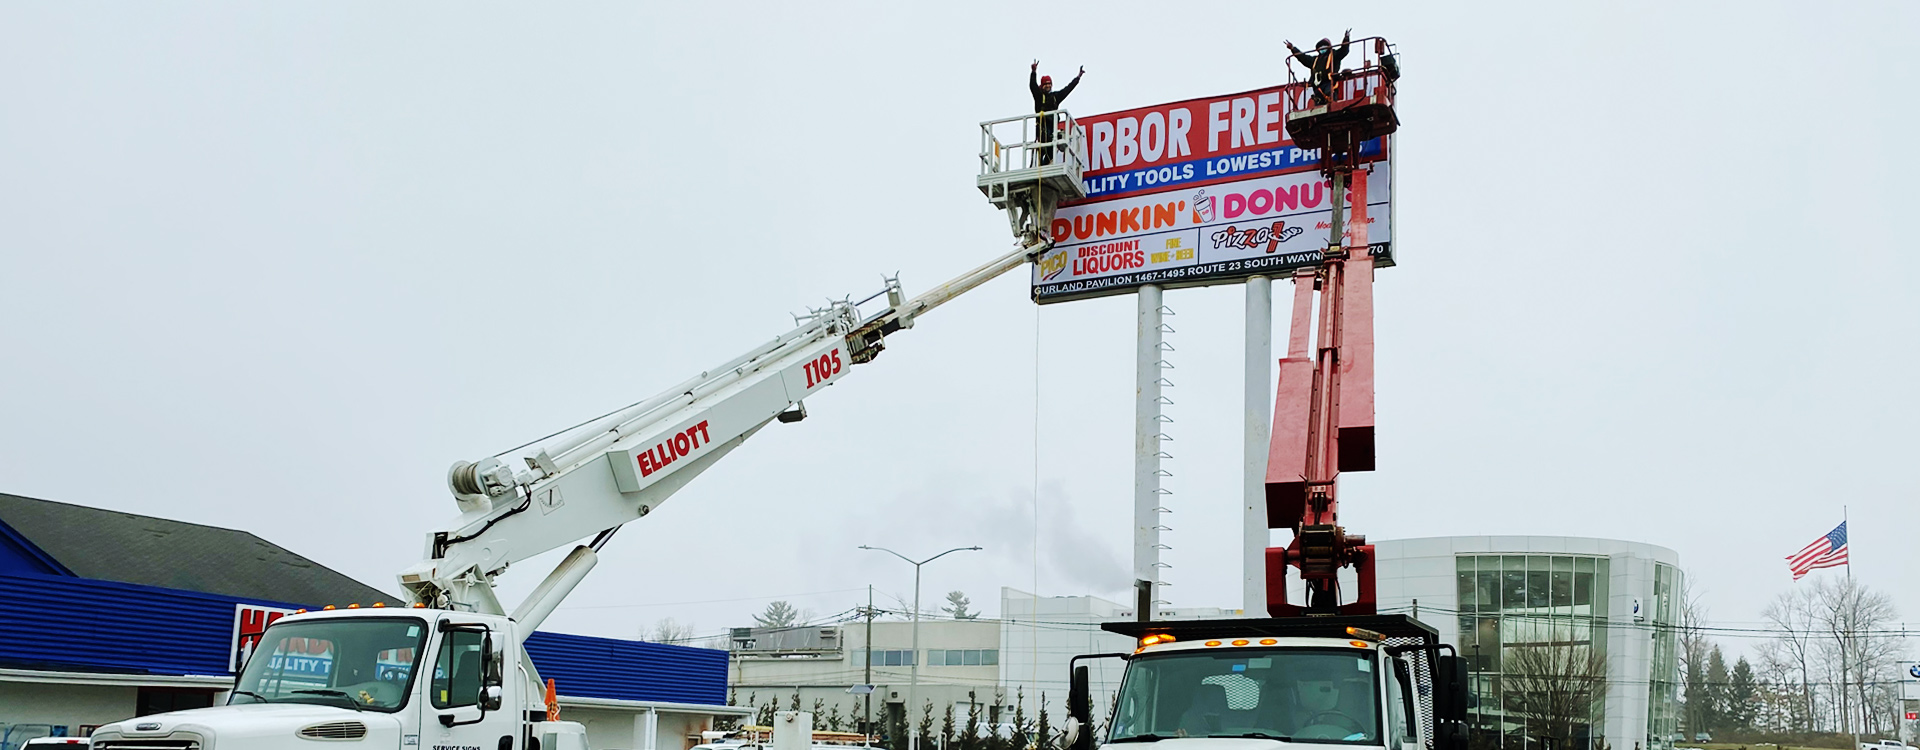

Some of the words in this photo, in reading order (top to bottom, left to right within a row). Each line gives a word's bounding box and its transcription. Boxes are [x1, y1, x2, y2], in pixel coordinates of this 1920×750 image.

[1057, 107, 1191, 172] ARBOR
[1082, 173, 1130, 194] ALITY
[1134, 163, 1194, 186] TOOLS
[1206, 149, 1284, 176] LOWEST
[1052, 200, 1185, 243] DUNKIN'
[1034, 281, 1083, 295] GURLAND
[1085, 276, 1132, 288] PAVILION
[1135, 267, 1185, 283] 1467-1495
[1187, 263, 1226, 277] ROUTE
[1229, 261, 1241, 271] 23
[1244, 256, 1284, 269] SOUTH
[1370, 245, 1384, 255] 70
[1041, 250, 1068, 278] PICO
[1073, 251, 1145, 276] LIQUORS
[1078, 239, 1140, 258] DISCOUNT
[636, 419, 710, 478] ELLIOTT
